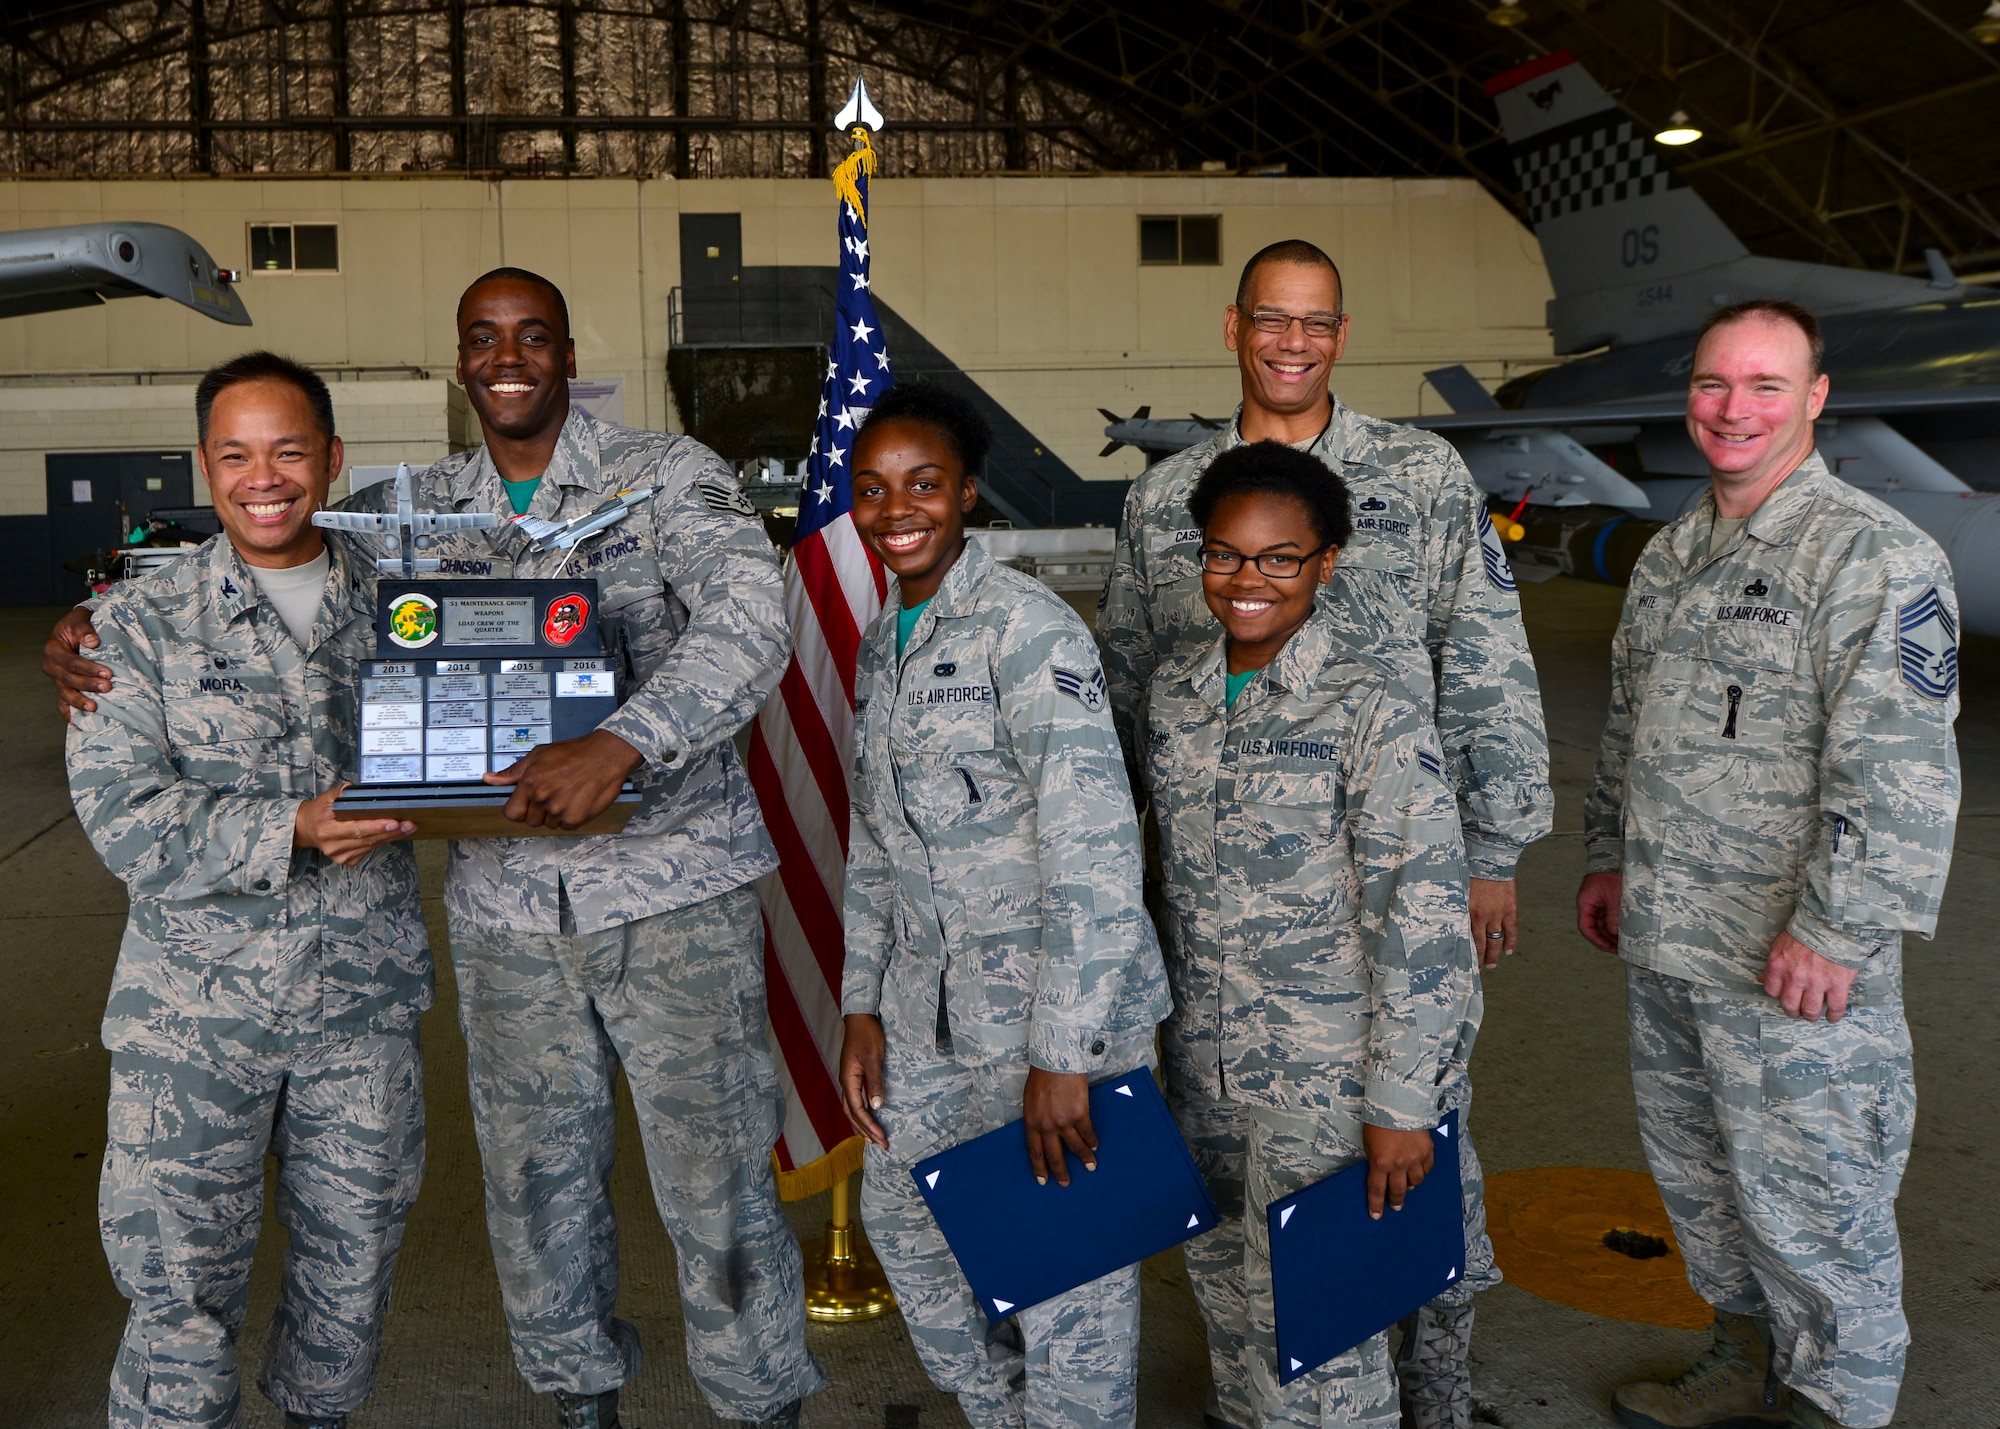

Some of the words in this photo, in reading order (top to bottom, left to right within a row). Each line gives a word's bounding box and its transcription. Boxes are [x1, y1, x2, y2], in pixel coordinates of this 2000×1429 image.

[1622, 224, 1660, 269] OS
[1357, 518, 1376, 529] AIR
[1378, 519, 1411, 537] FORCE
[565, 559, 584, 577] U.S.
[587, 551, 603, 568] AIR
[605, 535, 641, 560] FORCE
[440, 558, 492, 575] OHNSON
[1717, 606, 1732, 620] U.S.
[1732, 606, 1753, 620] AIR
[1752, 607, 1793, 626] FORCE
[382, 665, 406, 674] 2013
[447, 663, 470, 671] 2014
[511, 663, 534, 671] 2015
[573, 661, 596, 669] 2016
[200, 678, 243, 692] MORA
[908, 690, 925, 706] U.S.
[927, 688, 945, 704] AIR
[947, 686, 991, 703] FORCE
[1241, 740, 1262, 754] U.S.
[1266, 740, 1288, 756] AIR
[1290, 741, 1339, 761] FORCE
